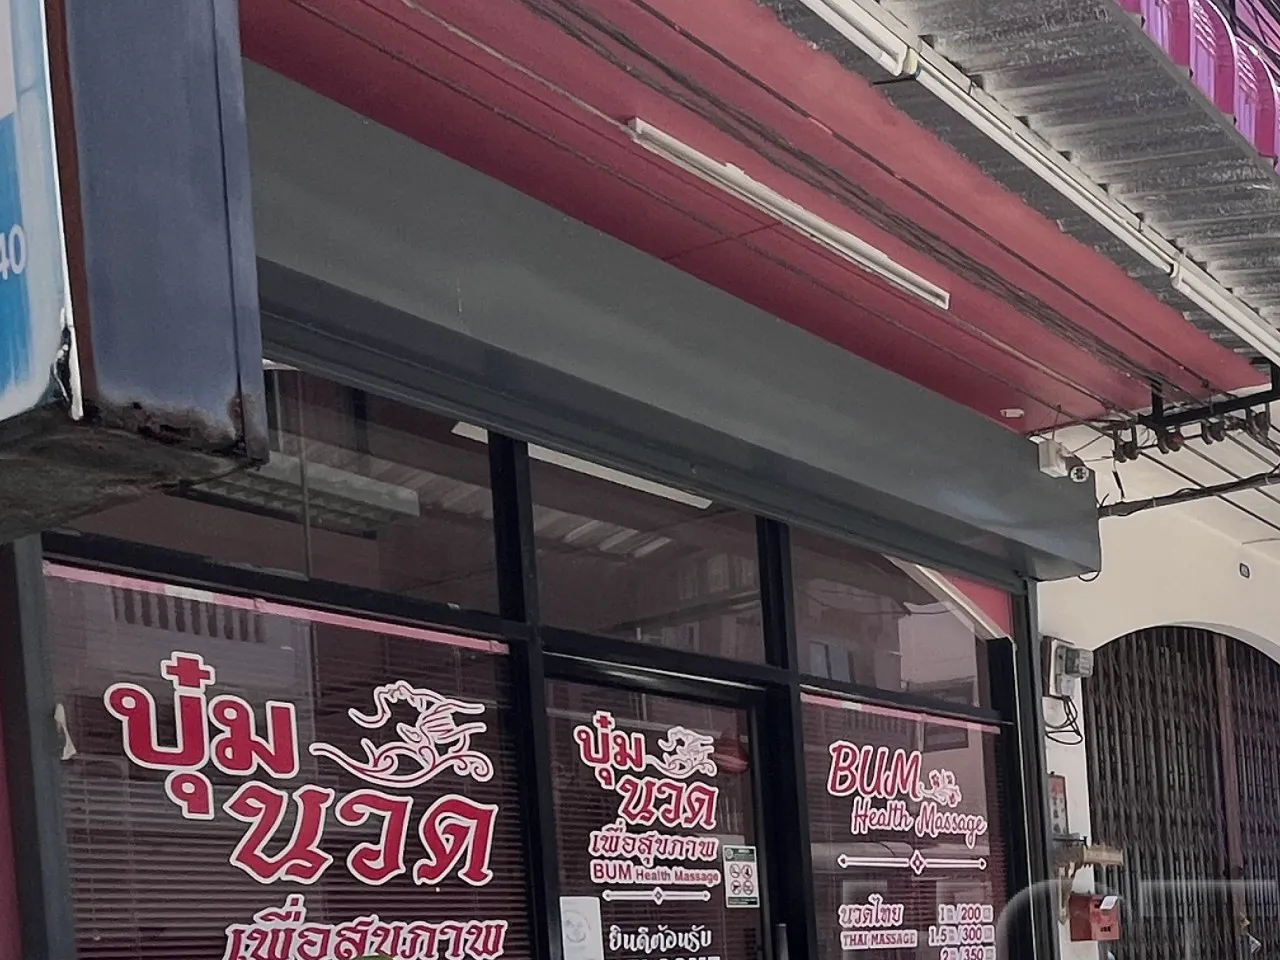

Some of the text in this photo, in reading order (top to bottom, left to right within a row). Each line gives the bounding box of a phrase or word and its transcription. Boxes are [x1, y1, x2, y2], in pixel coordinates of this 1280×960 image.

[104, 651, 299, 820] บุ๋ม
[574, 710, 646, 790] บุ๋ม
[827, 740, 922, 800] BUM
[616, 774, 718, 830] นวด
[851, 796, 988, 849] Health Massage
[222, 780, 498, 887] นวด
[588, 817, 718, 868] เพื่อสุขภาพ
[590, 858, 721, 887] BUM Health Massage
[839, 893, 904, 927] นวดไทย
[608, 924, 713, 954] ยินดีต้อนรับ
[841, 929, 918, 950] THAI MASSAGE
